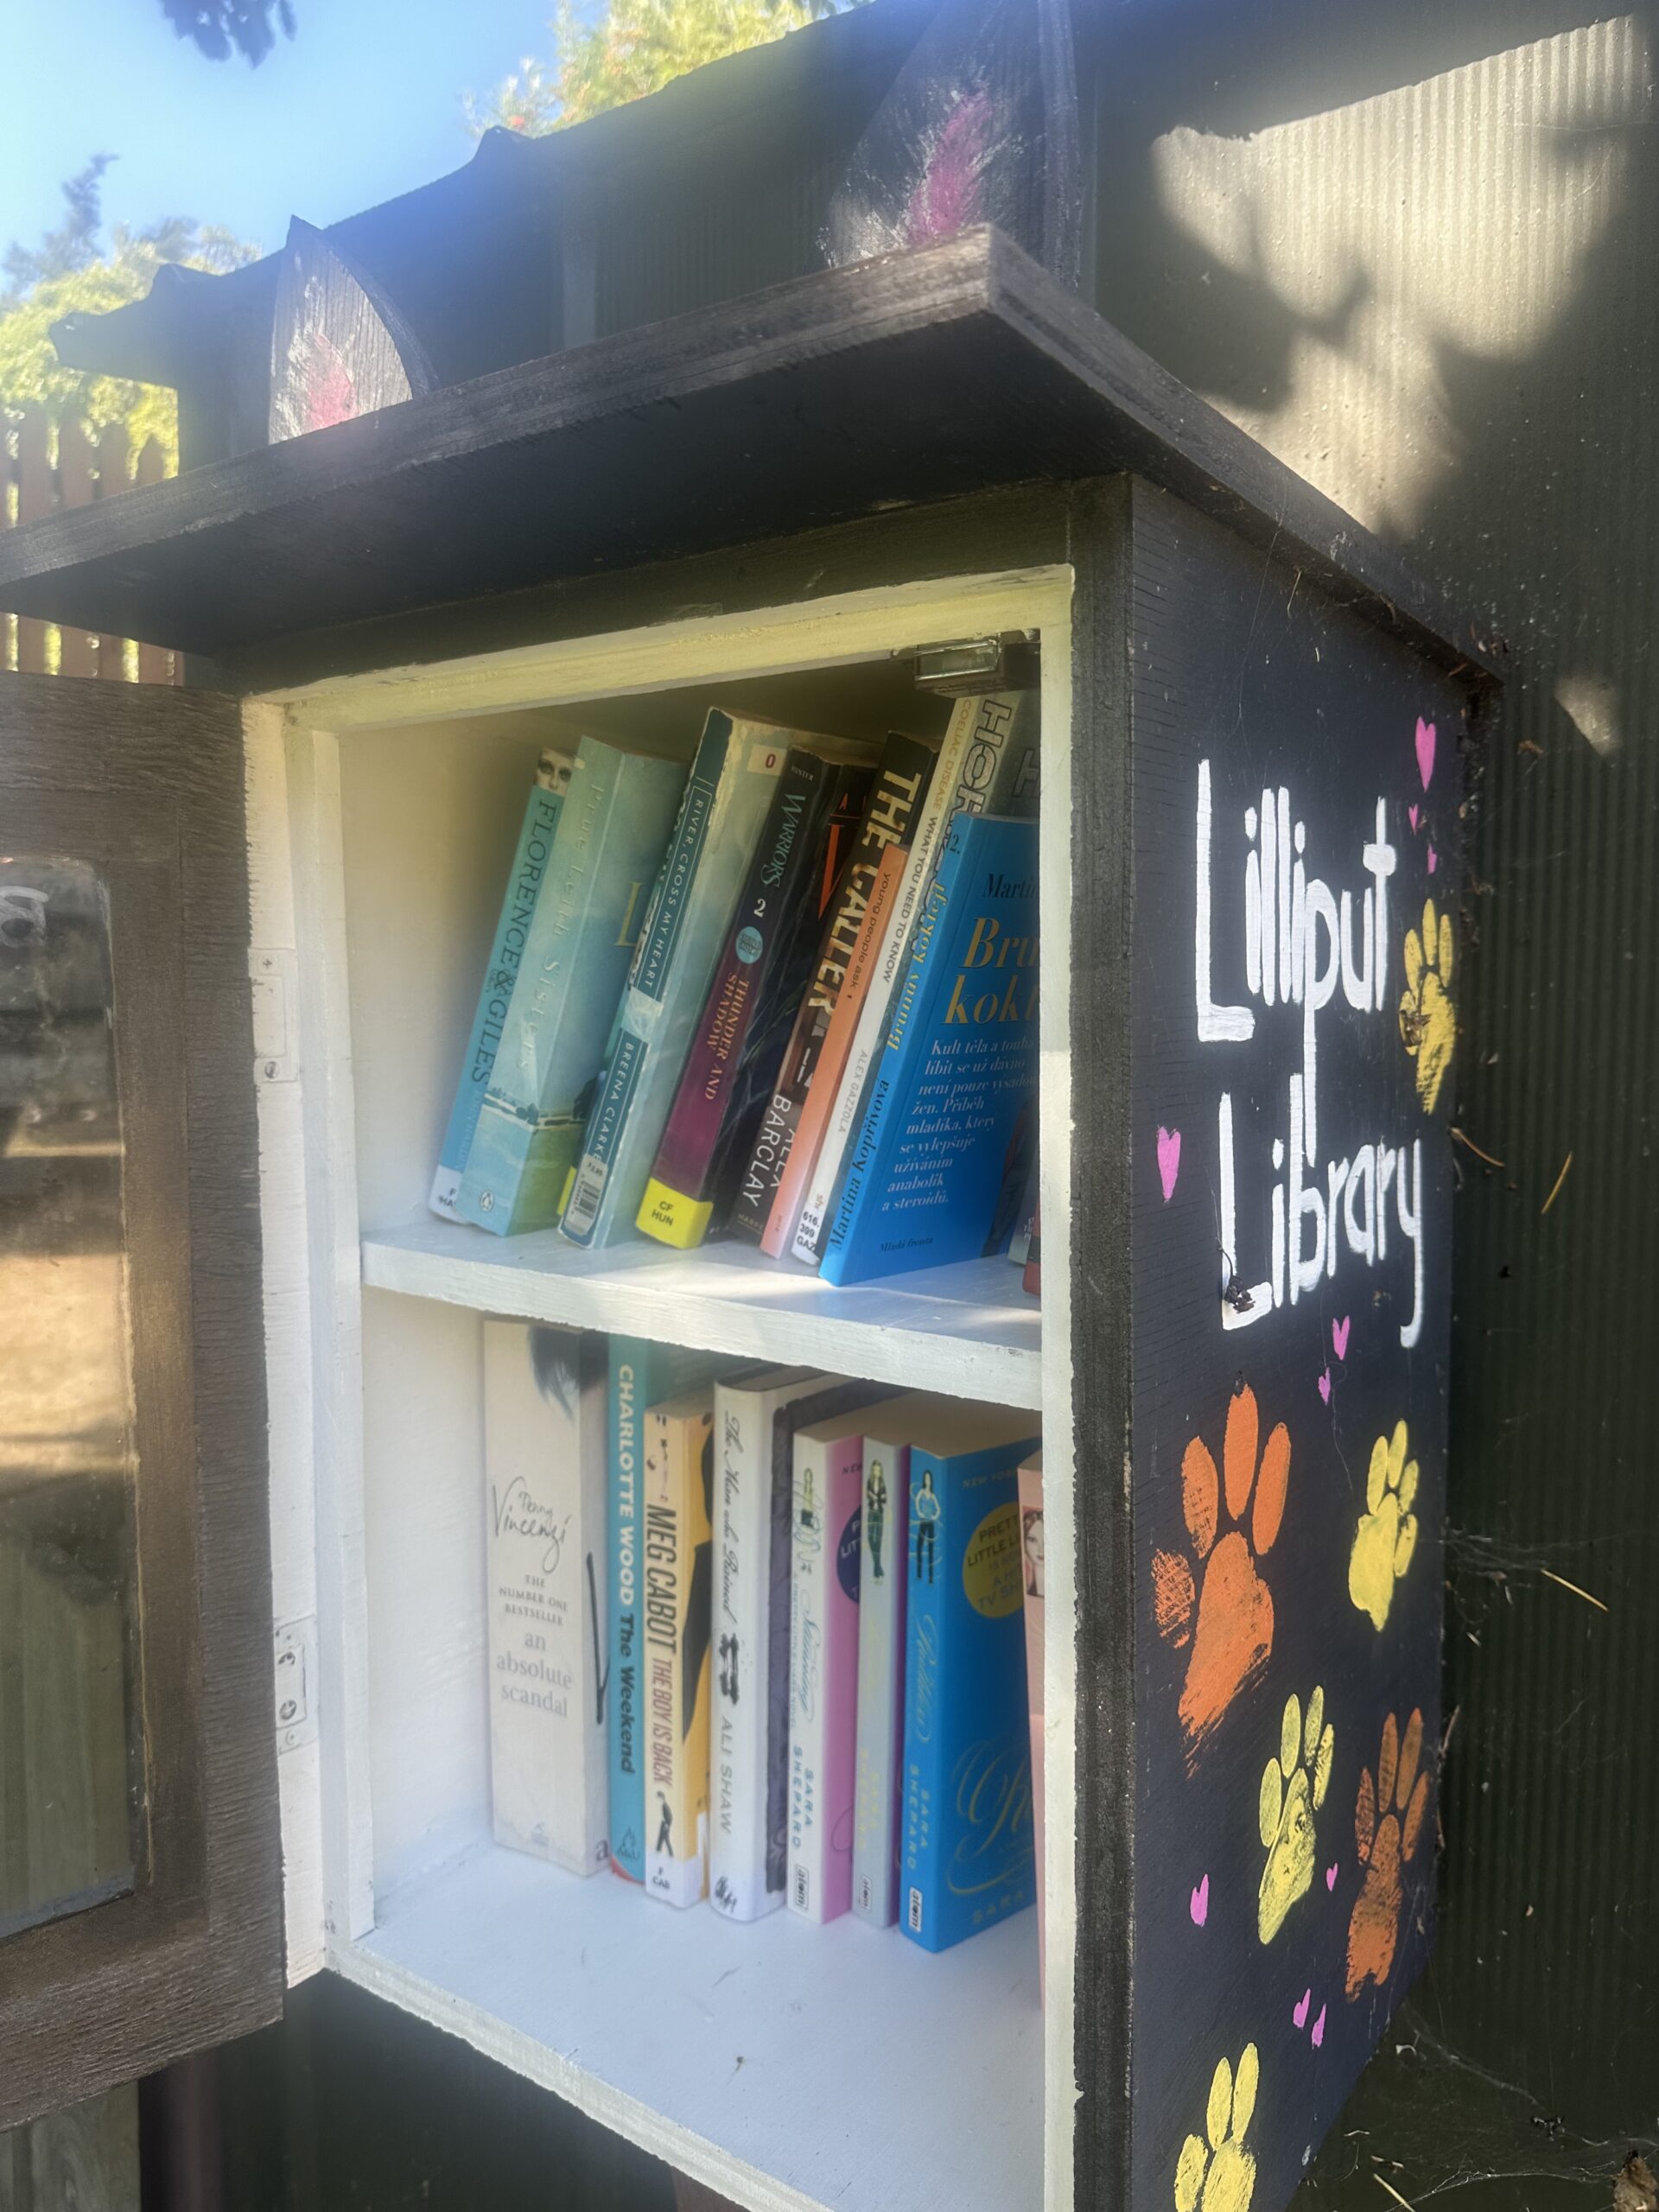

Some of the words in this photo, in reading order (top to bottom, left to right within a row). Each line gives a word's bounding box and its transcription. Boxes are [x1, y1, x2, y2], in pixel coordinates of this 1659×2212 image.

[948, 698, 972, 758] COELIAC
[932, 760, 955, 810] DISEASE
[681, 798, 705, 848] RIVER,
[861, 769, 922, 849] THE
[760, 793, 807, 888] WARRIORS
[921, 816, 938, 851] WHAT
[501, 798, 556, 969] FLORENCE
[667, 853, 690, 907] CROSS
[912, 851, 928, 883] YOU
[753, 899, 766, 918] 2
[868, 873, 892, 915] young
[903, 884, 918, 918] NEED
[659, 911, 672, 936] MY
[808, 862, 879, 1014] CALLER
[856, 916, 877, 965] people
[894, 918, 907, 940] TO
[645, 938, 665, 989] HEART
[849, 965, 862, 989] ask
[882, 940, 902, 984] KNOW
[1196, 759, 1397, 1167] Lilliput
[516, 955, 560, 1071] Sisters
[707, 972, 738, 1051] SHADOW
[716, 980, 750, 1061] THUNDER
[471, 999, 510, 1084] GILES
[931, 1038, 961, 1056] Kult
[964, 1036, 988, 1054] těla
[990, 1043, 998, 1052] a
[609, 1041, 635, 1101] BREENA
[704, 1065, 723, 1100] AND
[854, 1050, 868, 1084] ALEX
[918, 1078, 950, 1096] není
[950, 1080, 988, 1098] pouze
[956, 1063, 969, 1074] se
[973, 1057, 988, 1072] už
[838, 1084, 861, 1134] GAZZOLA
[592, 1106, 616, 1163] CLARKE
[743, 1094, 792, 1208] BARCLAY
[899, 1142, 914, 1154] se
[918, 1133, 976, 1156] vylepšuje
[438, 1194, 457, 1208] HA
[652, 1210, 675, 1227] HUN
[658, 1199, 674, 1211] CF
[829, 1176, 861, 1250] Martina
[881, 1202, 890, 1211] a
[1219, 1073, 1423, 1349] Library
[799, 1223, 815, 1238] 399
[619, 1363, 635, 1520] CHARLOTTE
[724, 1410, 744, 1454] The
[724, 1450, 739, 1506] Man
[493, 1475, 573, 1573] Vincenzi
[646, 1503, 677, 1565] MEG
[723, 1509, 738, 1543] who
[620, 1525, 635, 1605] WOOD
[967, 1540, 1007, 1567] LITTLE
[499, 1586, 544, 1605] NUMBER
[548, 1597, 568, 1612] ONE
[524, 1573, 545, 1589] THE
[722, 1542, 739, 1625] Rained
[505, 1603, 564, 1627] BESTSELLER
[646, 1565, 677, 1655] CABOT
[524, 1631, 547, 1651] an
[620, 1613, 634, 1658] The
[497, 1650, 574, 1690] absolute
[652, 1657, 672, 1689] THE
[501, 1684, 568, 1719] scandal
[620, 1667, 635, 1774] Weekend
[652, 1688, 672, 1722] BOY
[652, 1723, 672, 1743] IS
[720, 1713, 733, 1757] ALI
[652, 1742, 673, 1788] BACK
[720, 1765, 733, 1834] SHAW
[791, 1745, 804, 1849] SHEPARD
[804, 1767, 814, 1827] SARA
[907, 1764, 920, 1870] SHEPARD
[919, 1789, 930, 1848] SARA
[652, 1876, 671, 1890] CAB
[911, 1891, 922, 1929] atom
